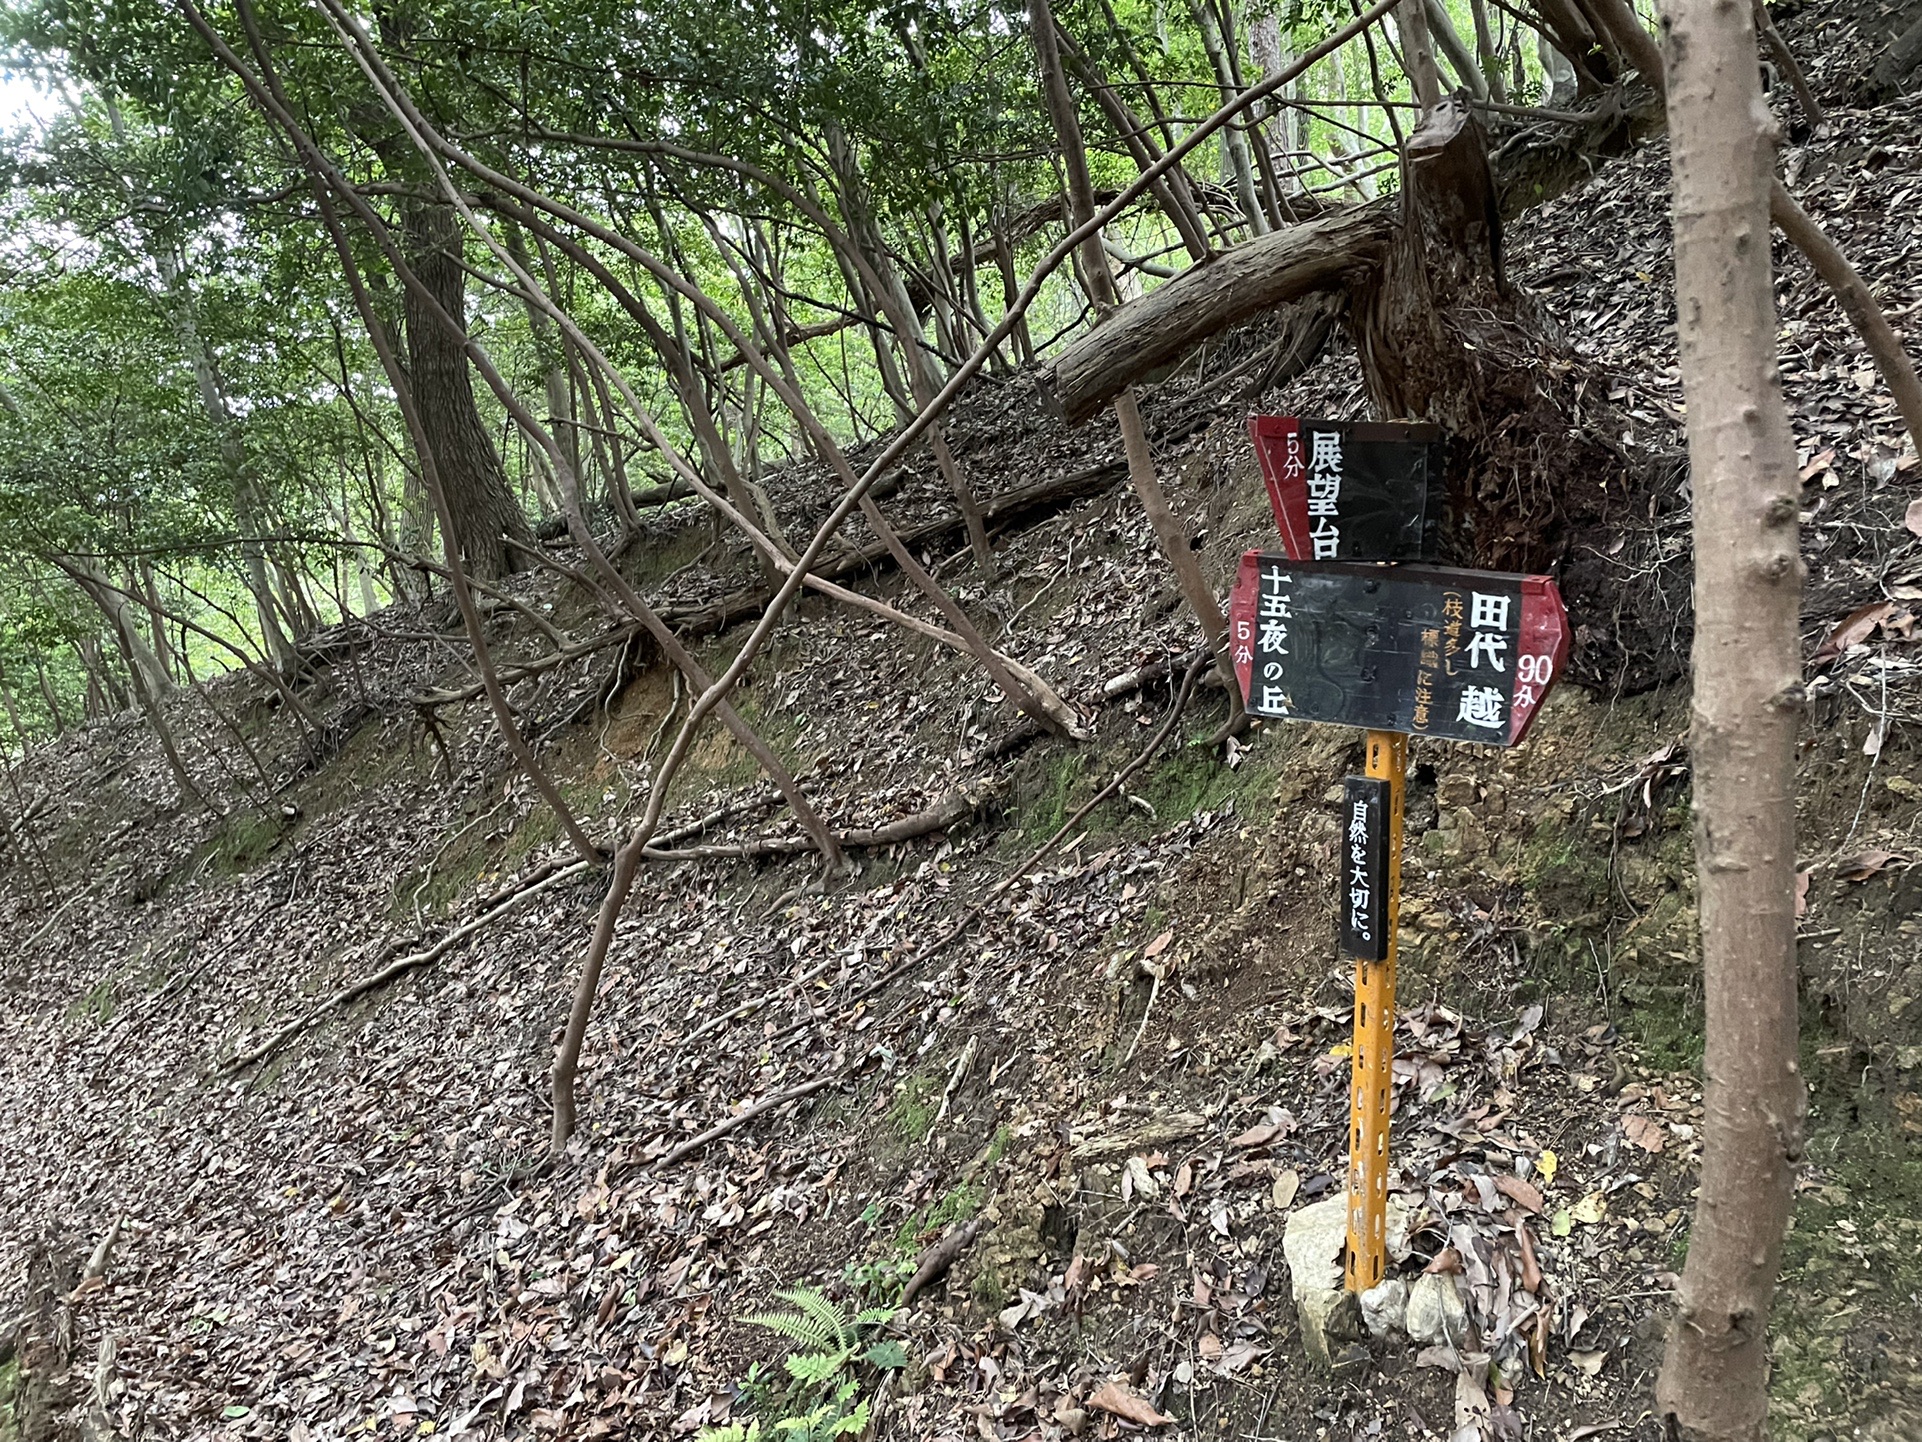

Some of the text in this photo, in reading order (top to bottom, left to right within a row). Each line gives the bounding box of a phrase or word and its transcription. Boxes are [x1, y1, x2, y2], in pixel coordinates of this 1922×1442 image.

[1283, 432, 1305, 480] 5分
[1307, 430, 1344, 560] 展望台
[1234, 621, 1254, 664] 5分
[1257, 565, 1293, 714] 十五夜の丘
[1456, 591, 1511, 729] 田代越
[1513, 654, 1553, 708] 90分
[1348, 800, 1371, 942] 自然を大切に。
